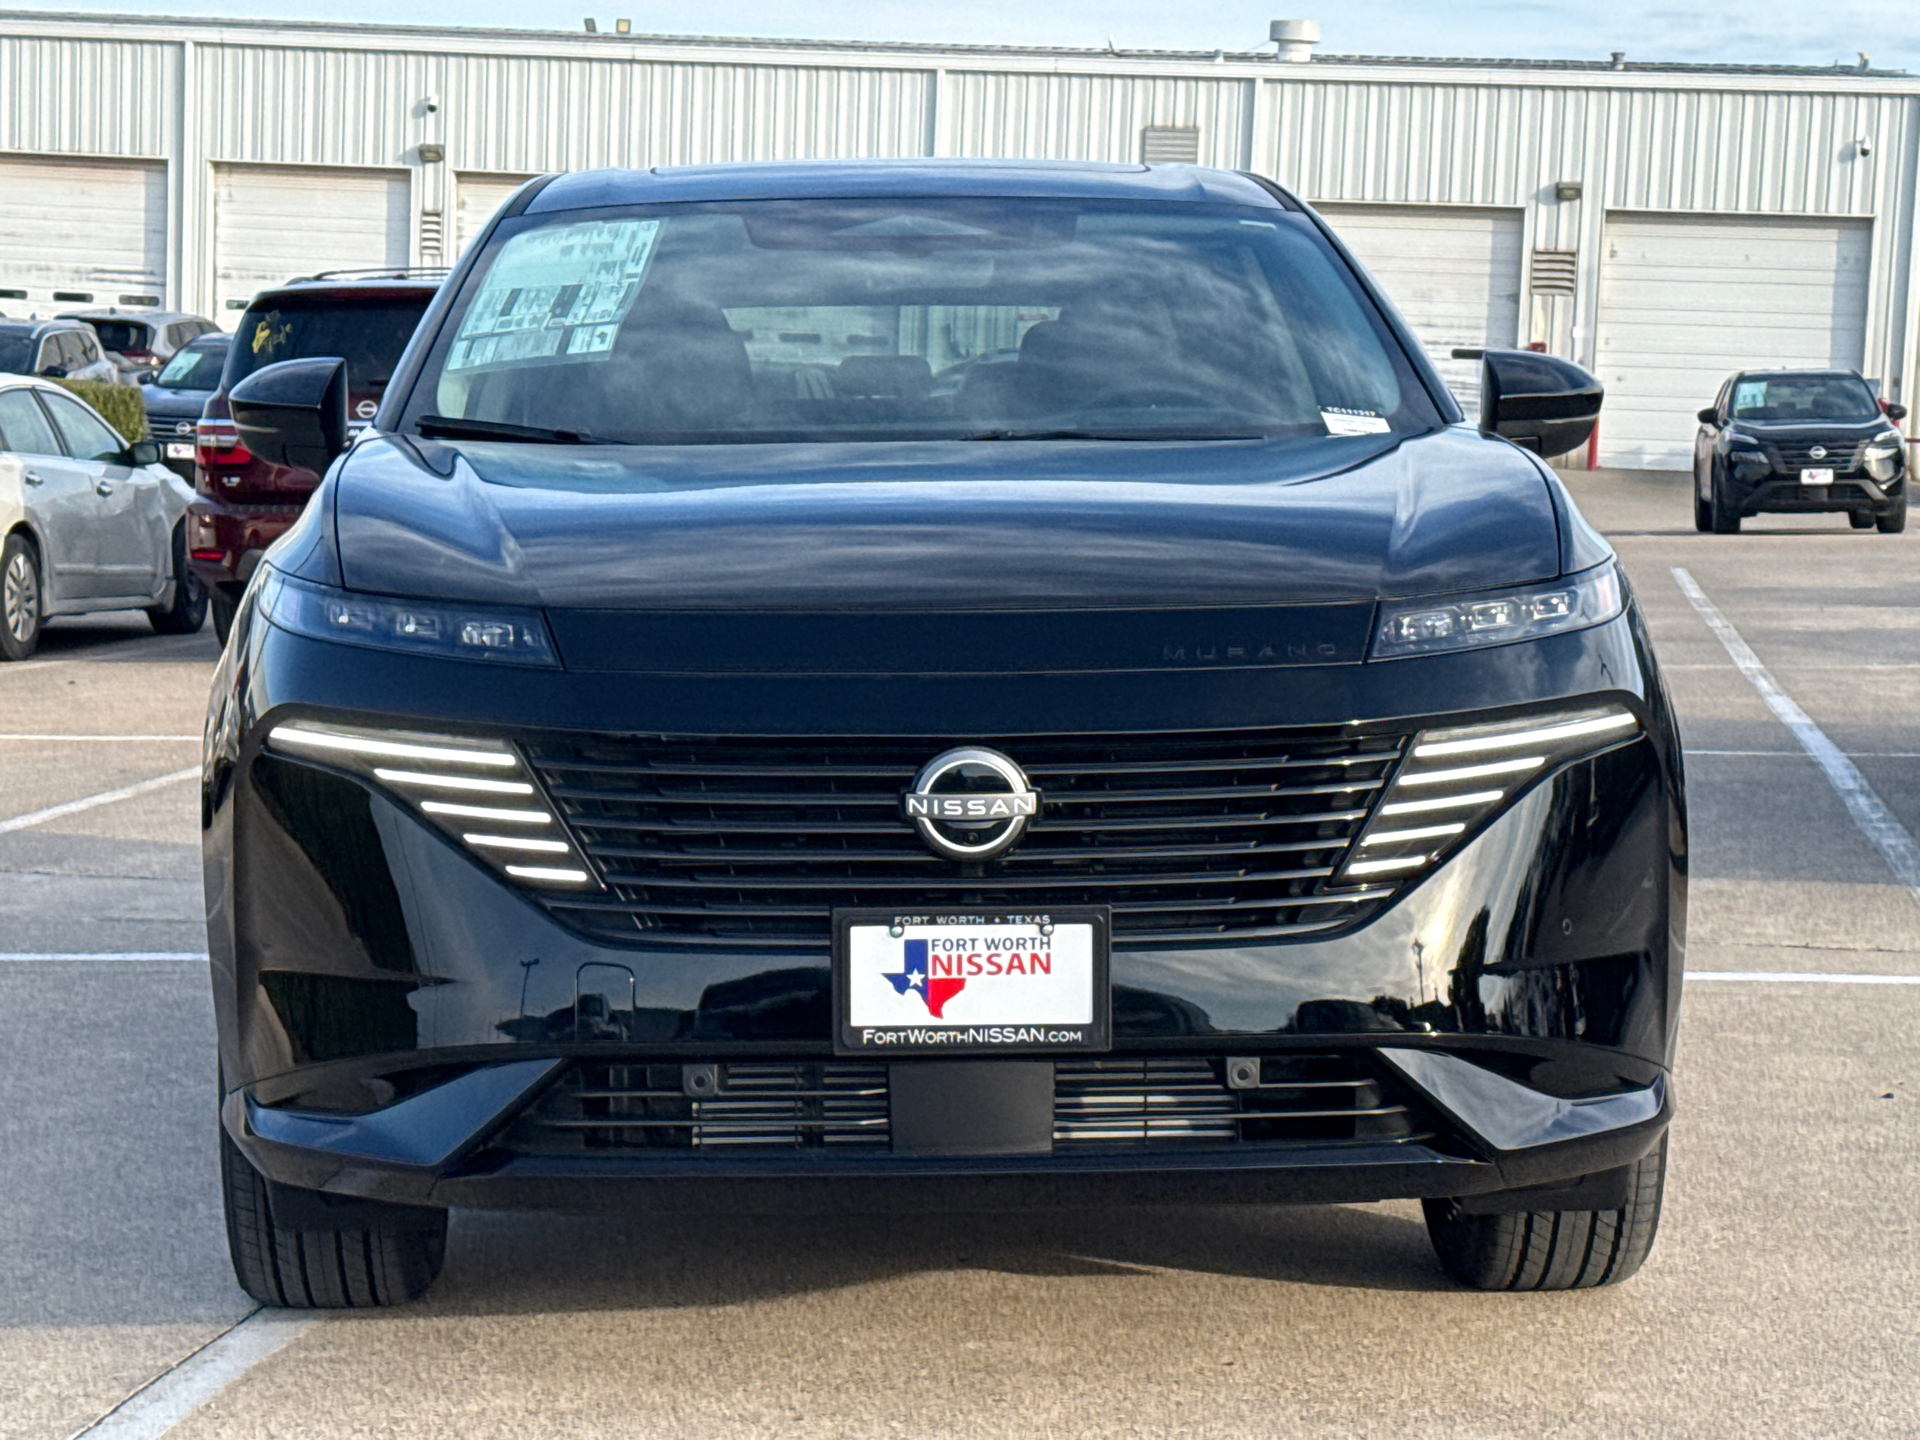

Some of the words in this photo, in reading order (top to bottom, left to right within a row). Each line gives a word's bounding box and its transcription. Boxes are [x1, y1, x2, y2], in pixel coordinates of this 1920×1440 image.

[1163, 643, 1336, 661] MURANO
[908, 798, 1034, 816] NISSAN
[894, 915, 930, 925] FORT
[936, 915, 985, 925] WORTH
[1006, 914, 1051, 925] TEXAS
[931, 938, 979, 952] FORT
[985, 937, 1051, 951] WORTH
[931, 952, 1052, 976] NISSAN
